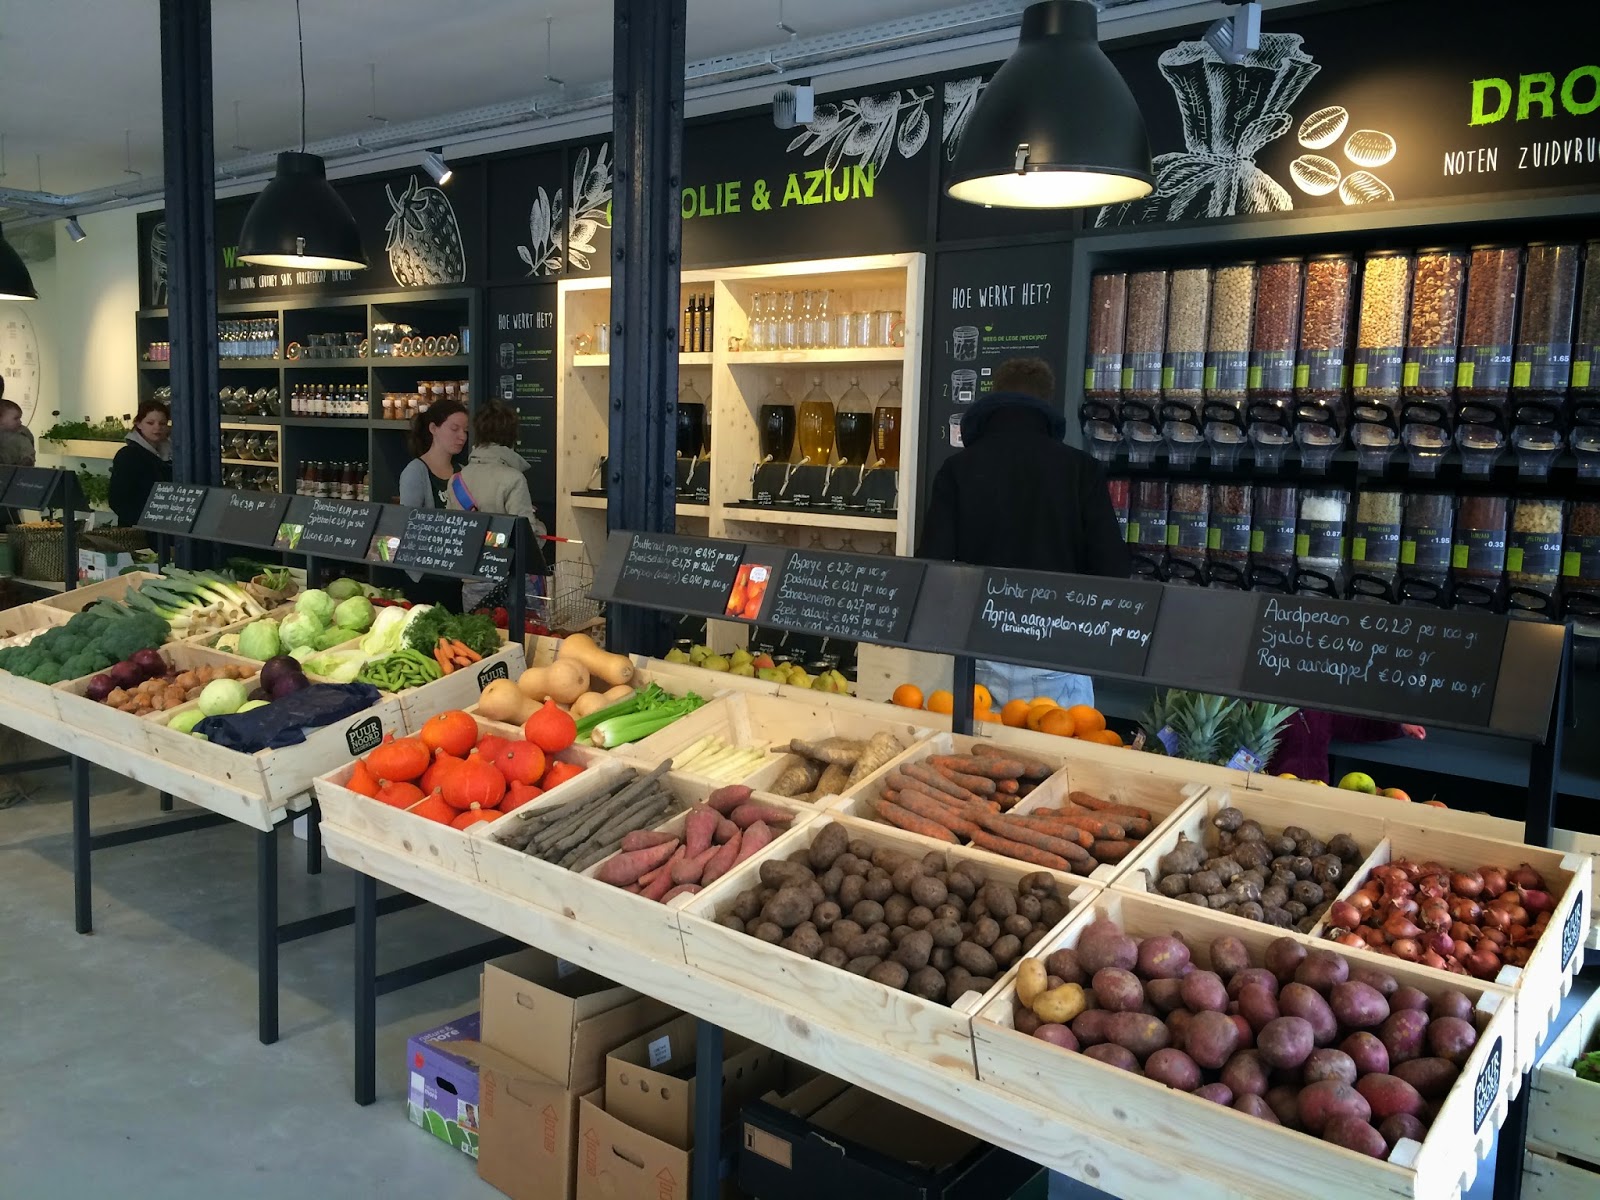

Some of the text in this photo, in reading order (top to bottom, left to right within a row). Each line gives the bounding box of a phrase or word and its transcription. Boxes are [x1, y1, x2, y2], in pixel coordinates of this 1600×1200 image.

[1467, 65, 1600, 127] DRO
[1443, 137, 1600, 176] NOTEN ZUIDVRU
[751, 179, 772, 211] &
[780, 162, 876, 208] AZIJN
[952, 282, 1052, 310] HOE WERKT HET?
[498, 312, 554, 330] HOE WERKT HET?
[787, 552, 822, 576] Asperge
[987, 577, 1028, 598] Winter
[982, 599, 1016, 628] Agria
[1263, 598, 1350, 632] Aardperen
[1416, 625, 1435, 643] per
[1443, 628, 1461, 639] 100
[1261, 625, 1314, 648] Sjalot
[1395, 647, 1413, 659] 100
[1257, 648, 1291, 676] Raja
[349, 722, 378, 742] PUUR
[352, 731, 380, 749] NOORD
